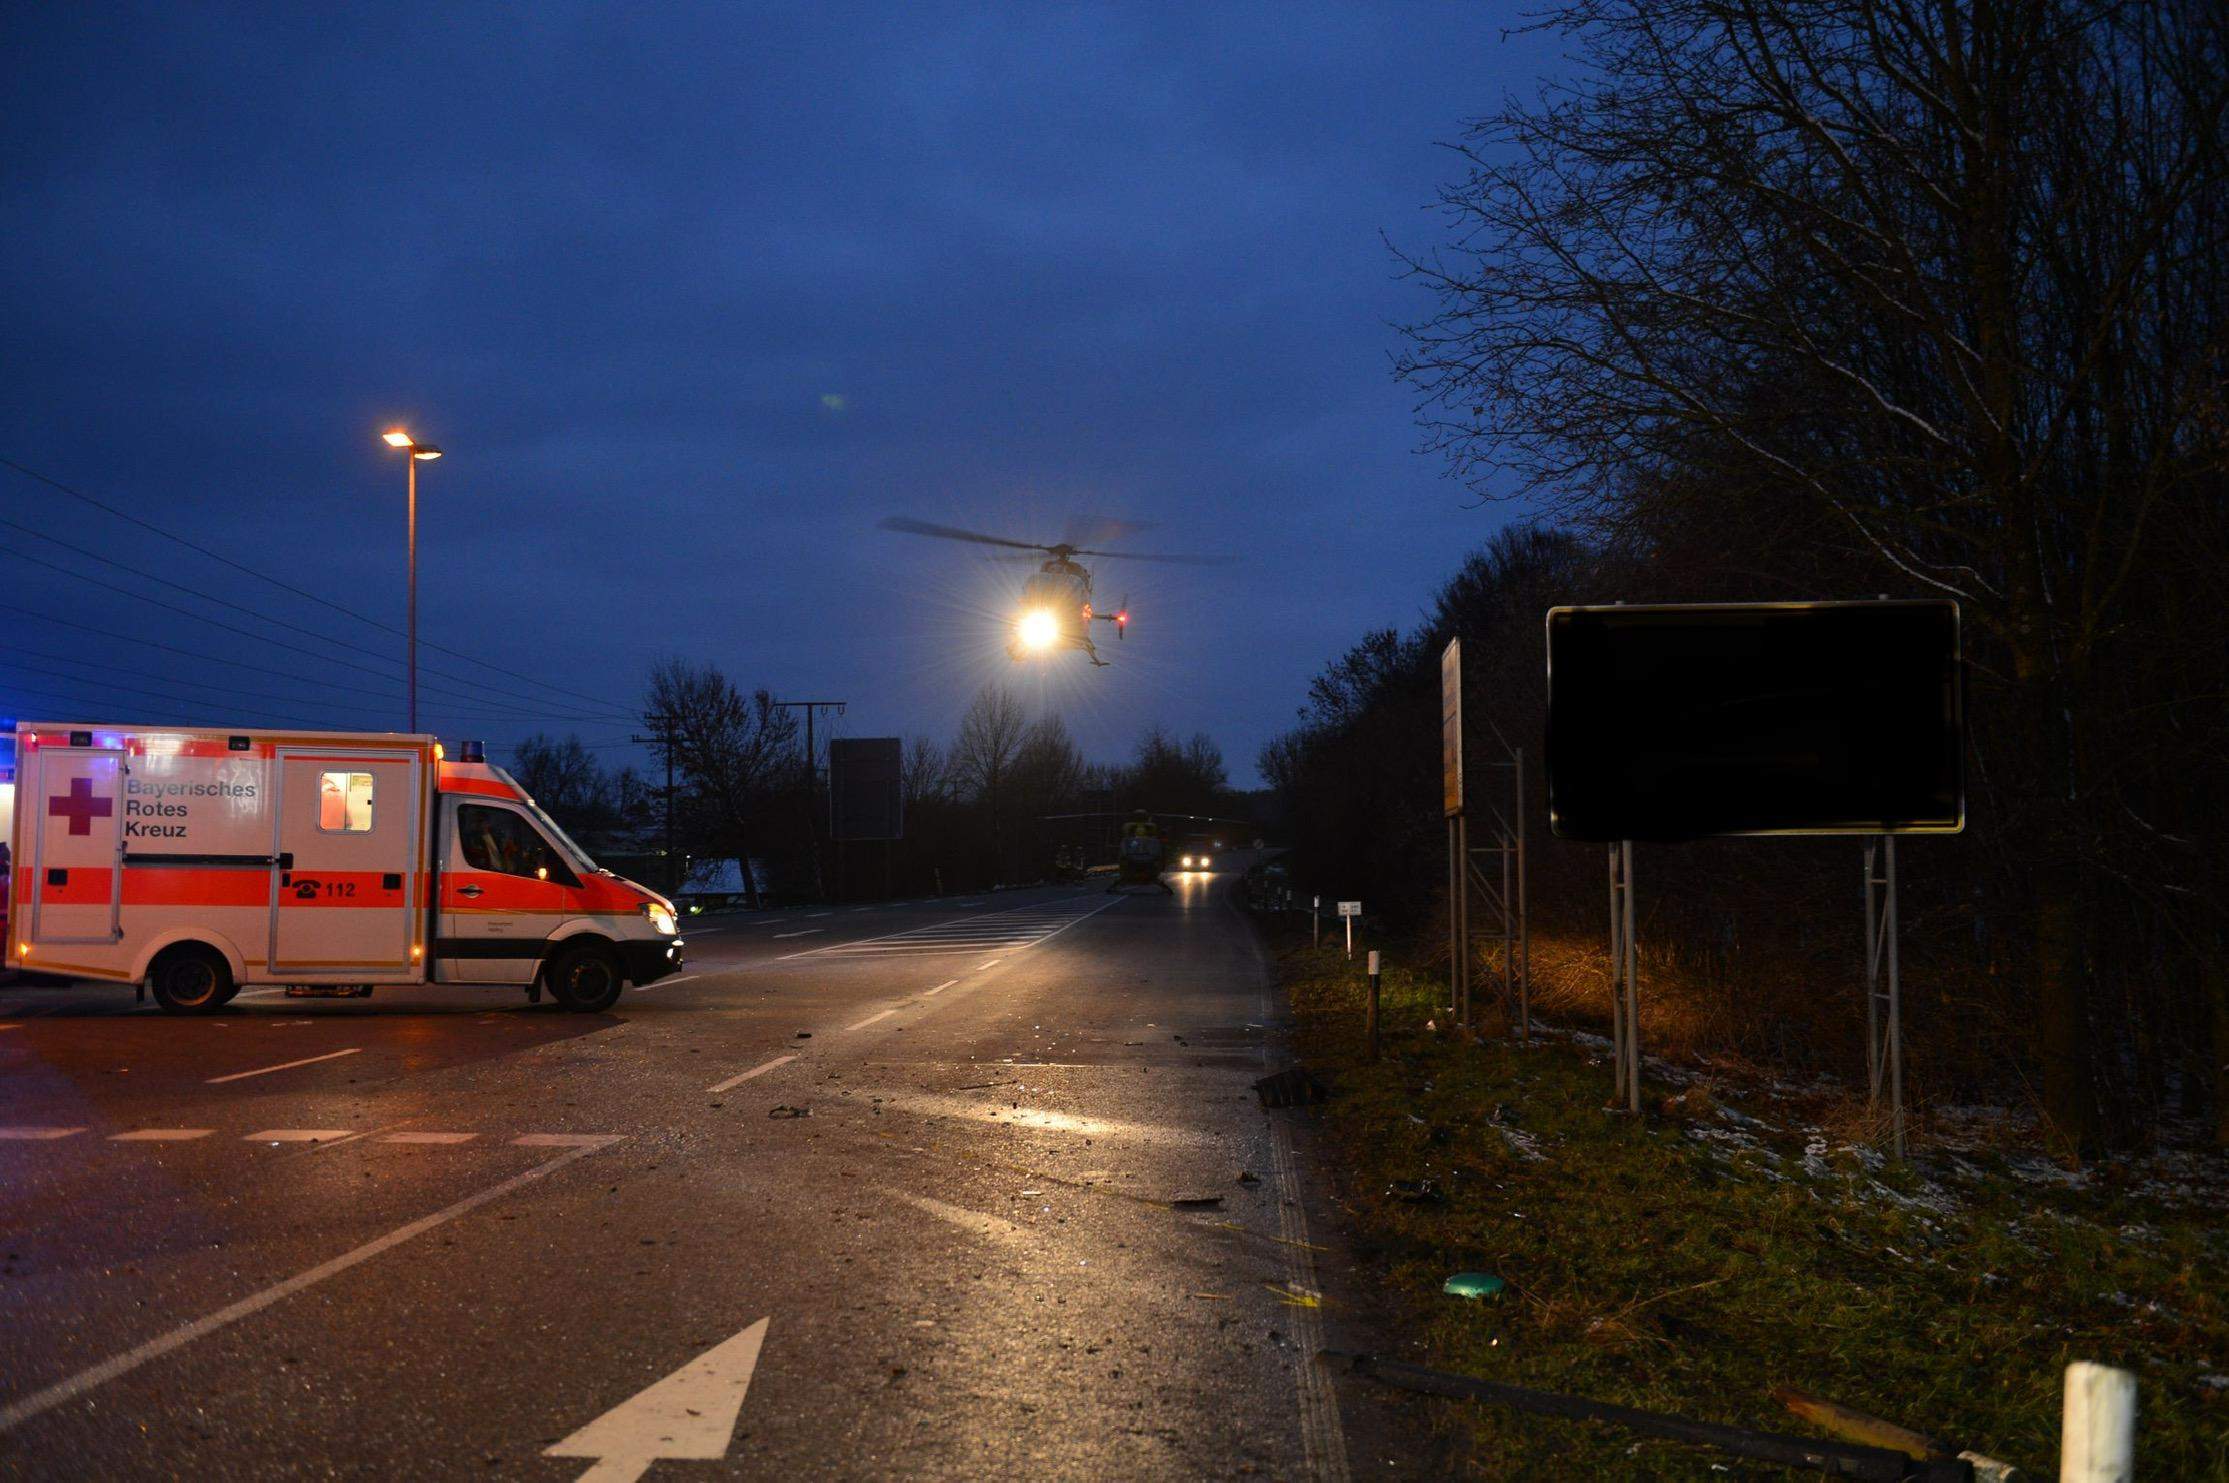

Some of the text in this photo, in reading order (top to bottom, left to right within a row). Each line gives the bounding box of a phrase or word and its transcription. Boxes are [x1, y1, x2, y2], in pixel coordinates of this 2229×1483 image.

[127, 779, 256, 798] Bayerisches
[126, 799, 188, 817] Rotes
[125, 821, 187, 838] Kreuz
[326, 883, 356, 897] 112
